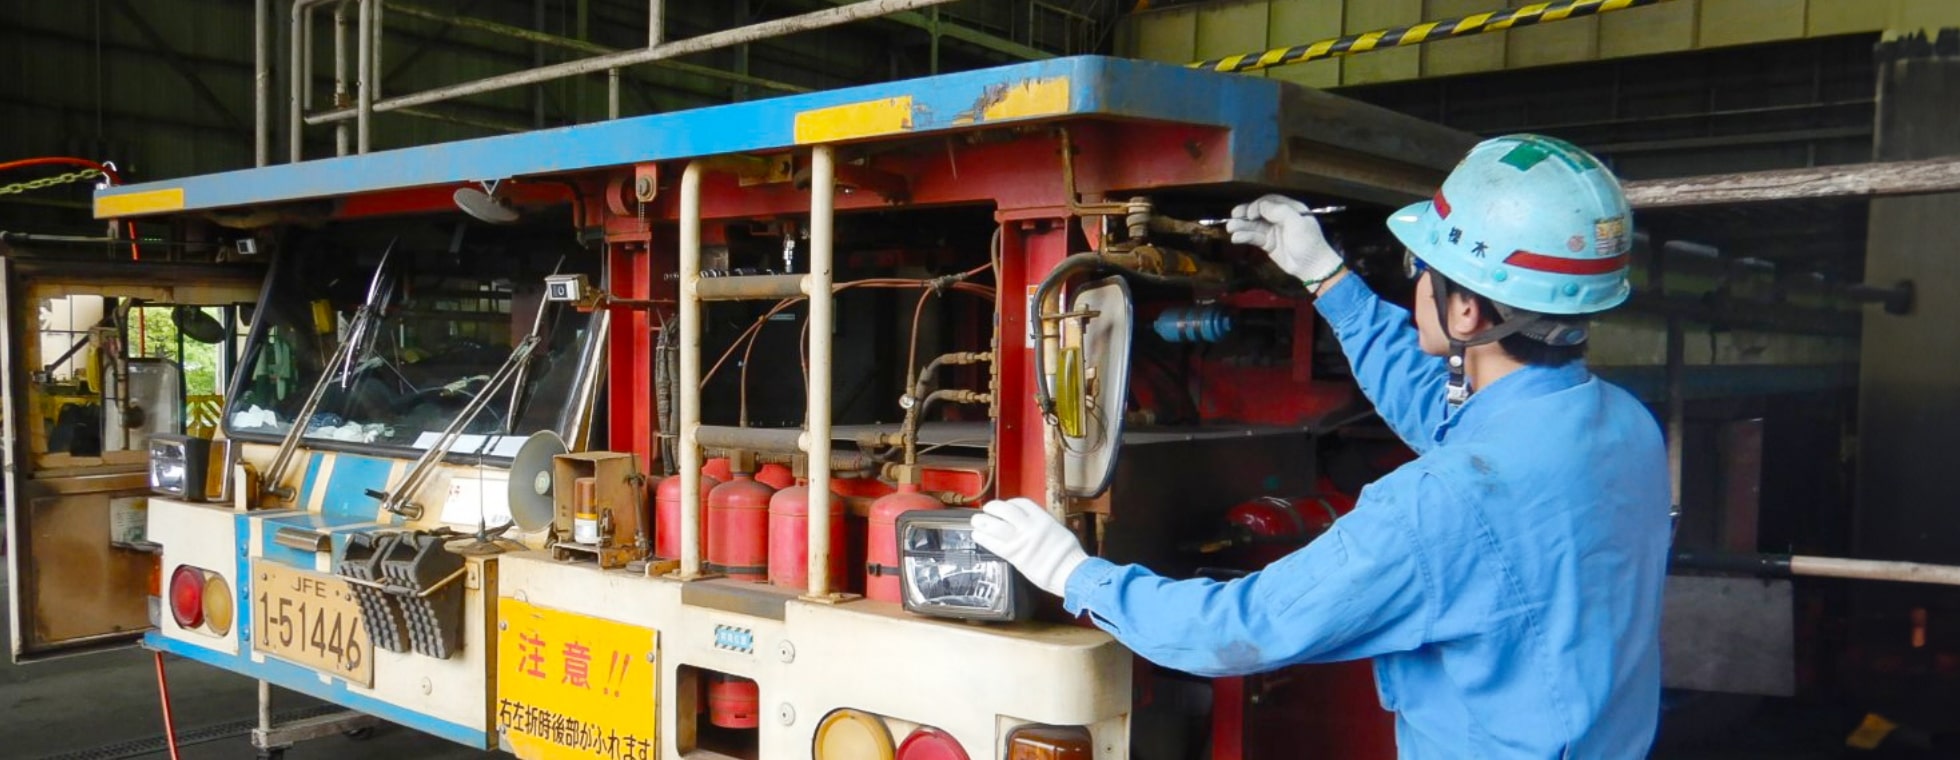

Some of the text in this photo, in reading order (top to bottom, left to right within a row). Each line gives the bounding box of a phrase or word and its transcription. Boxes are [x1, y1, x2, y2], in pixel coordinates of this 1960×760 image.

[292, 576, 327, 598] JFE
[260, 591, 361, 670] 1-51446
[499, 698, 651, 760] 右左折時後部がふれます
